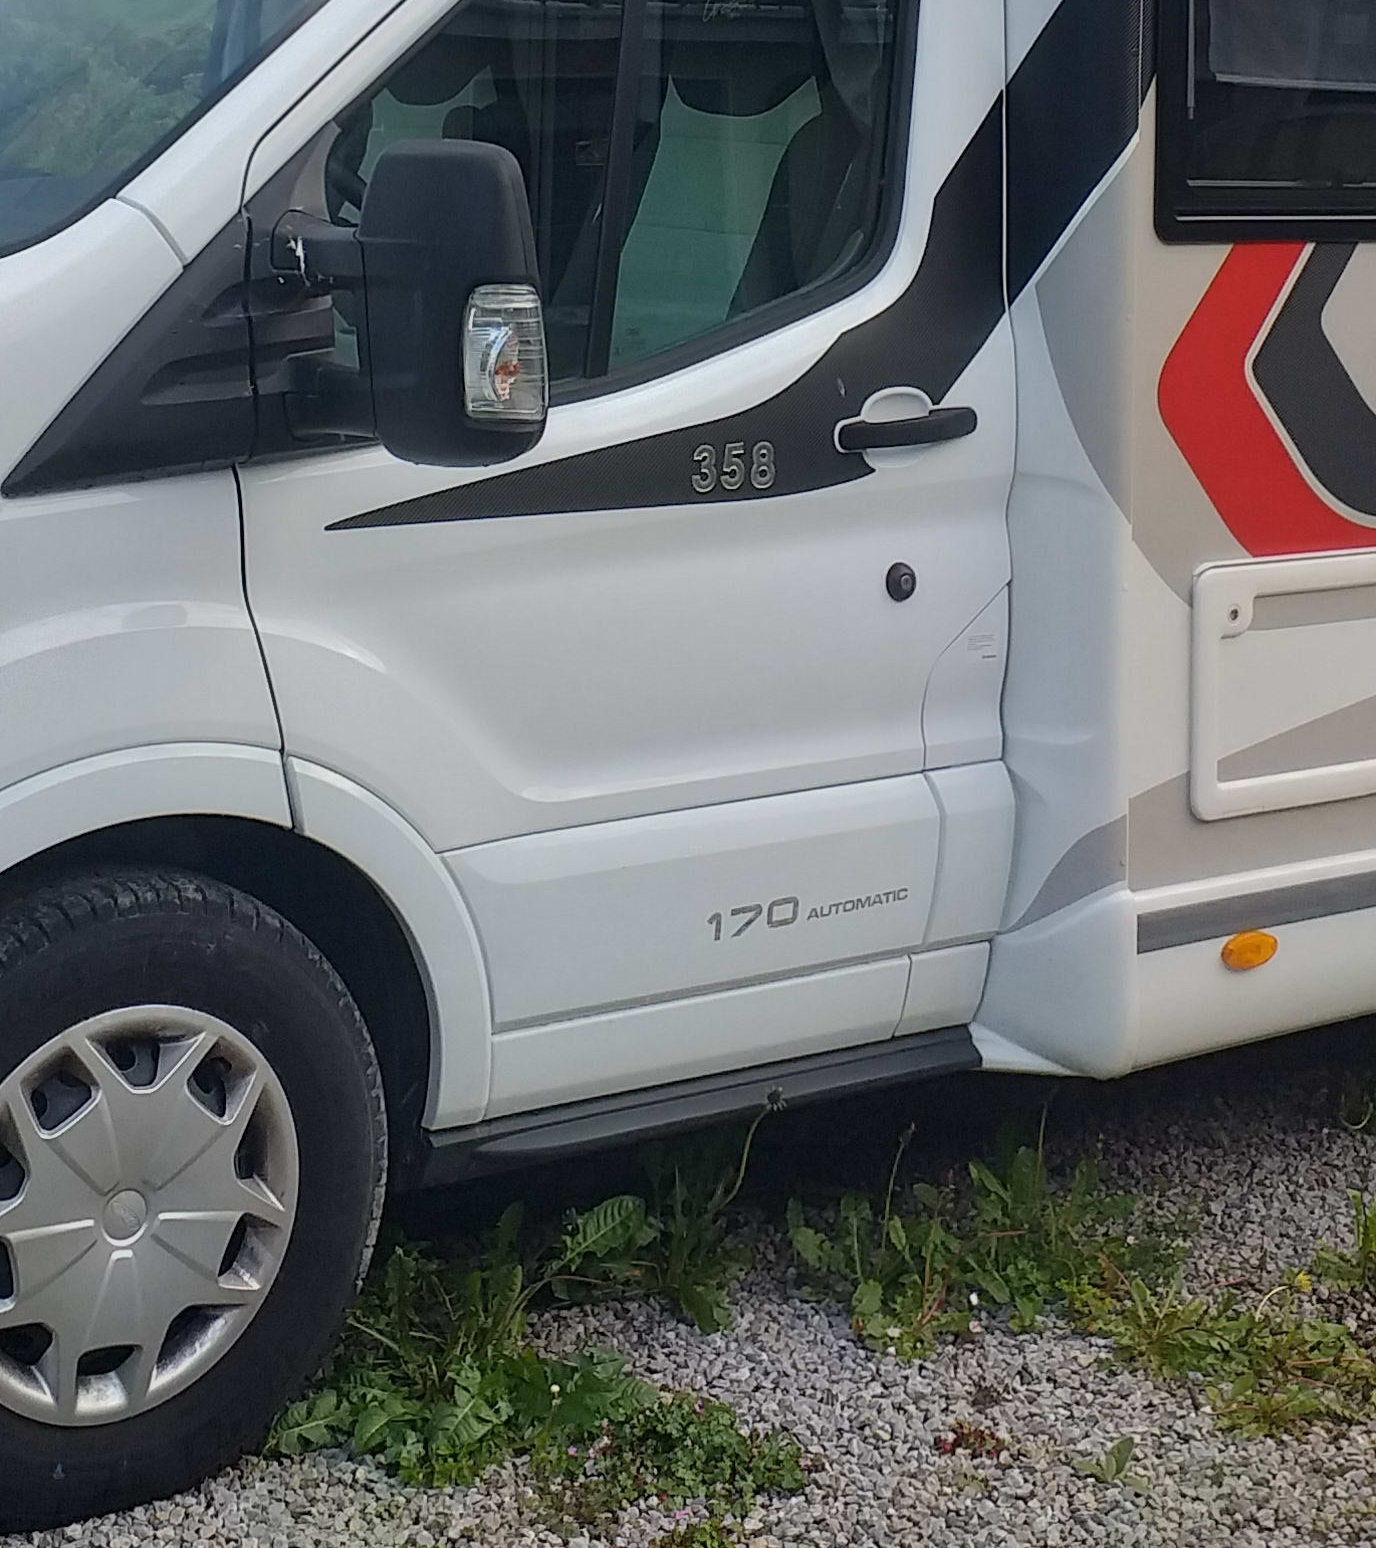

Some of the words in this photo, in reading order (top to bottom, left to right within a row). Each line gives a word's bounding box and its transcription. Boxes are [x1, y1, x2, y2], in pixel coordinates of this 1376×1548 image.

[691, 441, 776, 493] 358
[707, 896, 799, 941] 170
[807, 888, 908, 920] AUTOMATIC
